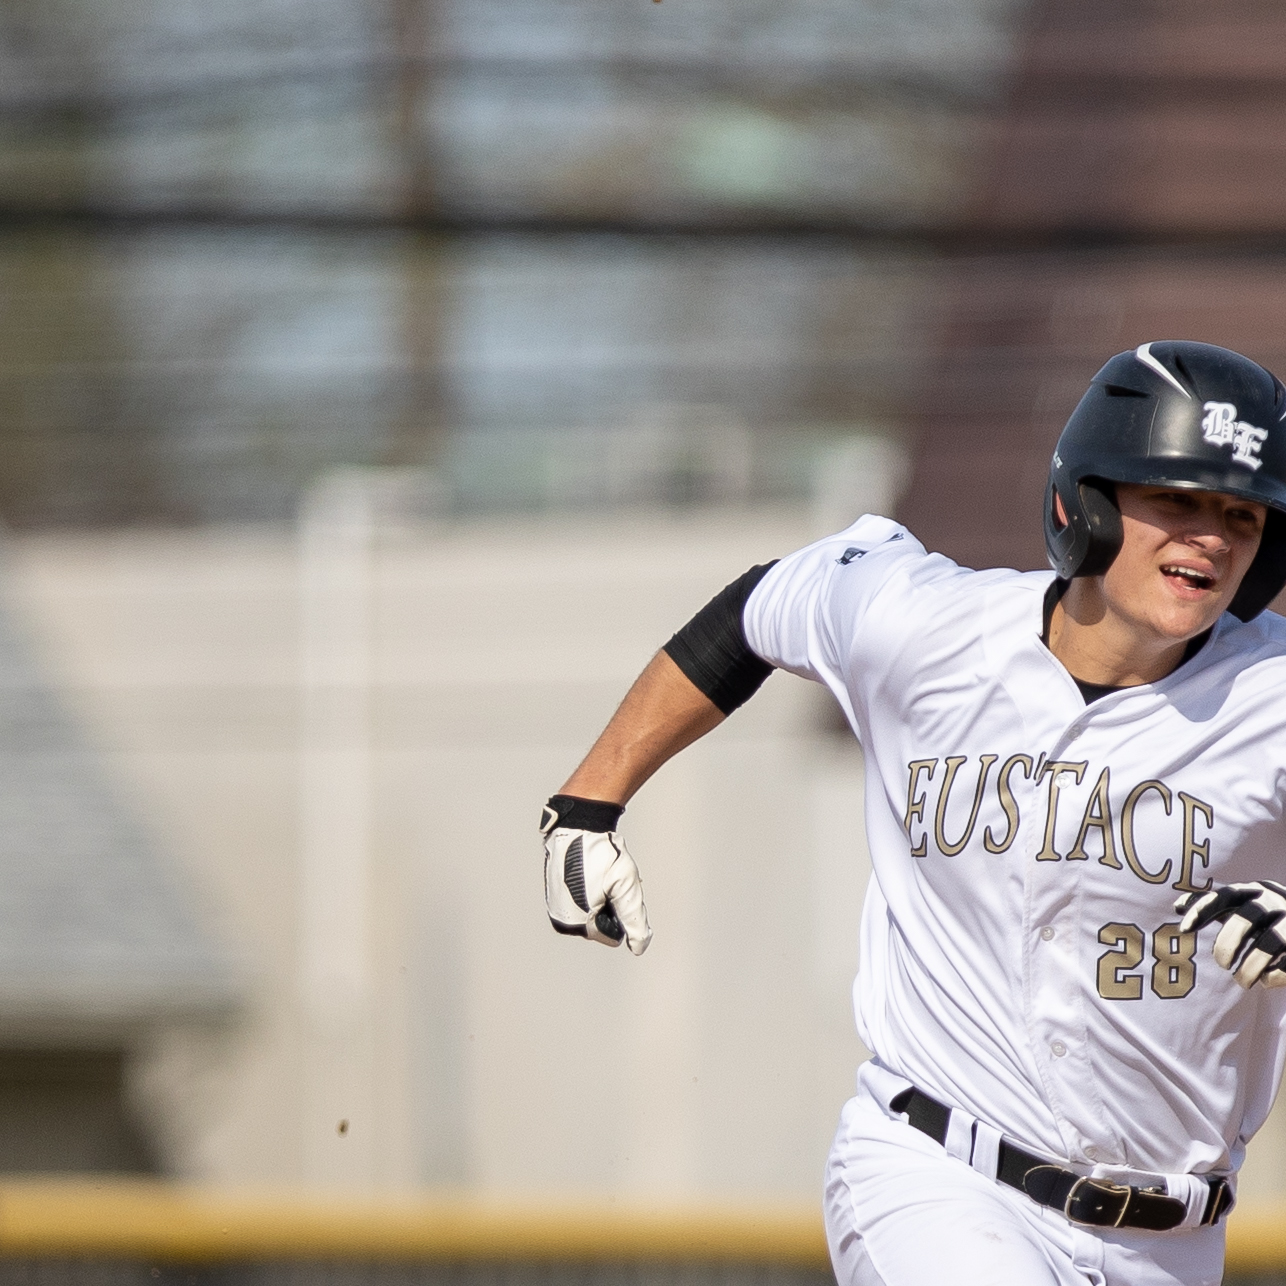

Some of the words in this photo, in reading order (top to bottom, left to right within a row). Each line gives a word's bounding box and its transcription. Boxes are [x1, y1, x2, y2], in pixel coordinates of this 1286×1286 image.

[1202, 401, 1269, 471] BE
[904, 752, 1215, 893] EUSTACE
[1096, 922, 1198, 1000] 28
